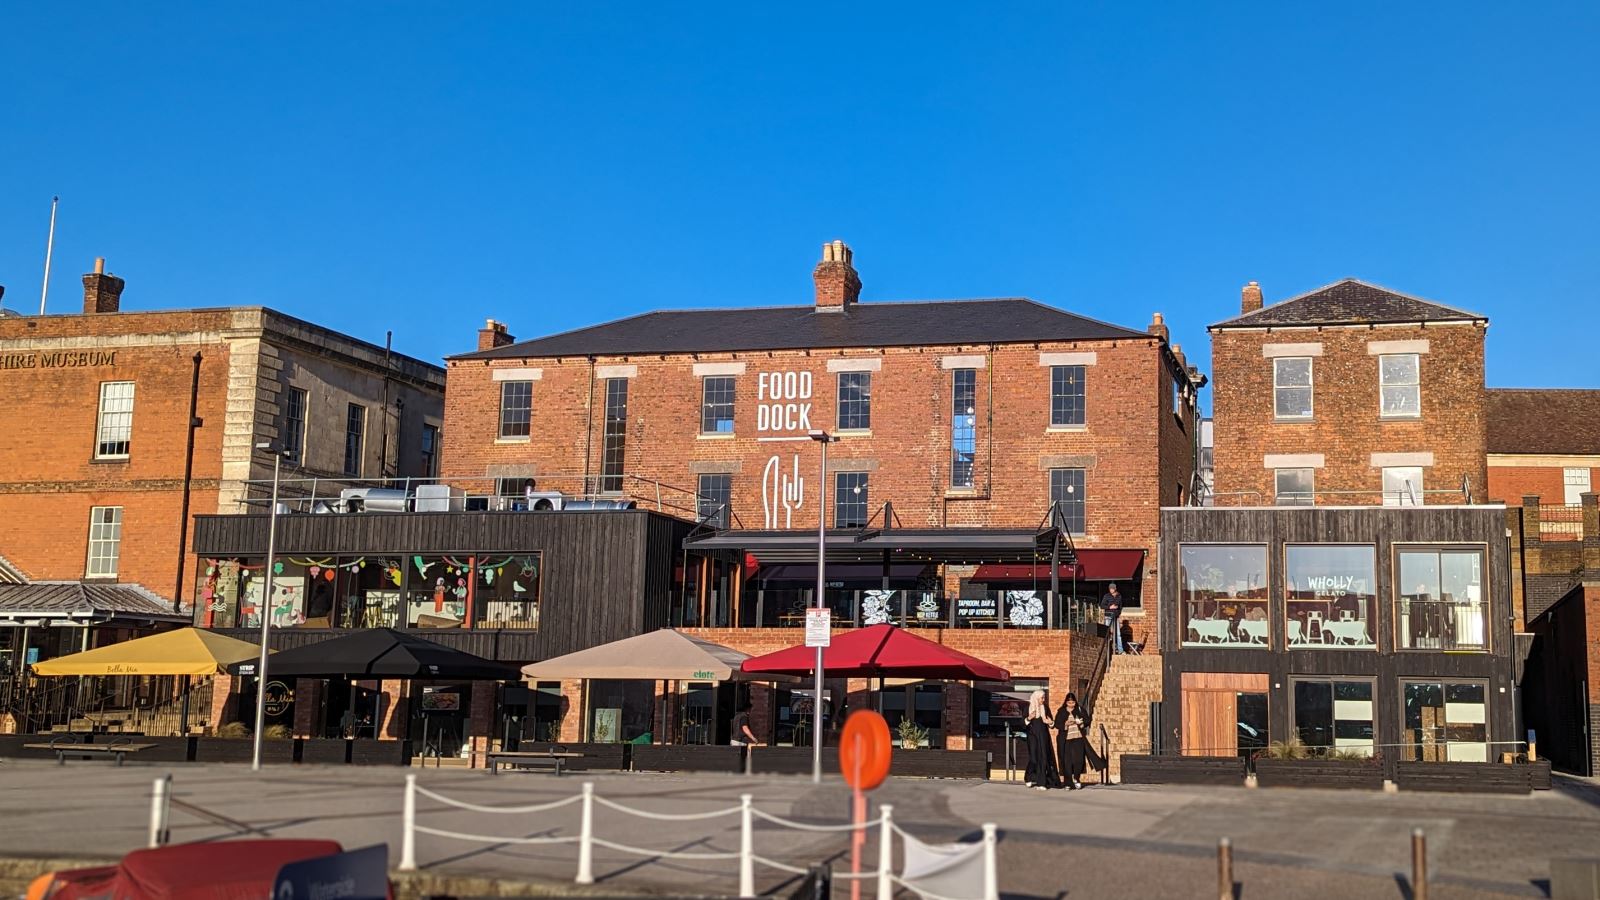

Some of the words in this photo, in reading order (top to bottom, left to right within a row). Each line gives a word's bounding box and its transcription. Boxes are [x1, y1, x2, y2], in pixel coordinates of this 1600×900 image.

[41, 352, 116, 368] MUSEUM
[758, 371, 812, 400] FOOD
[757, 403, 812, 431] DOCK
[1308, 575, 1353, 590] WHOLLY
[958, 608, 968, 616] POP
[968, 608, 976, 616] UP
[975, 608, 996, 616] KITCHEN
